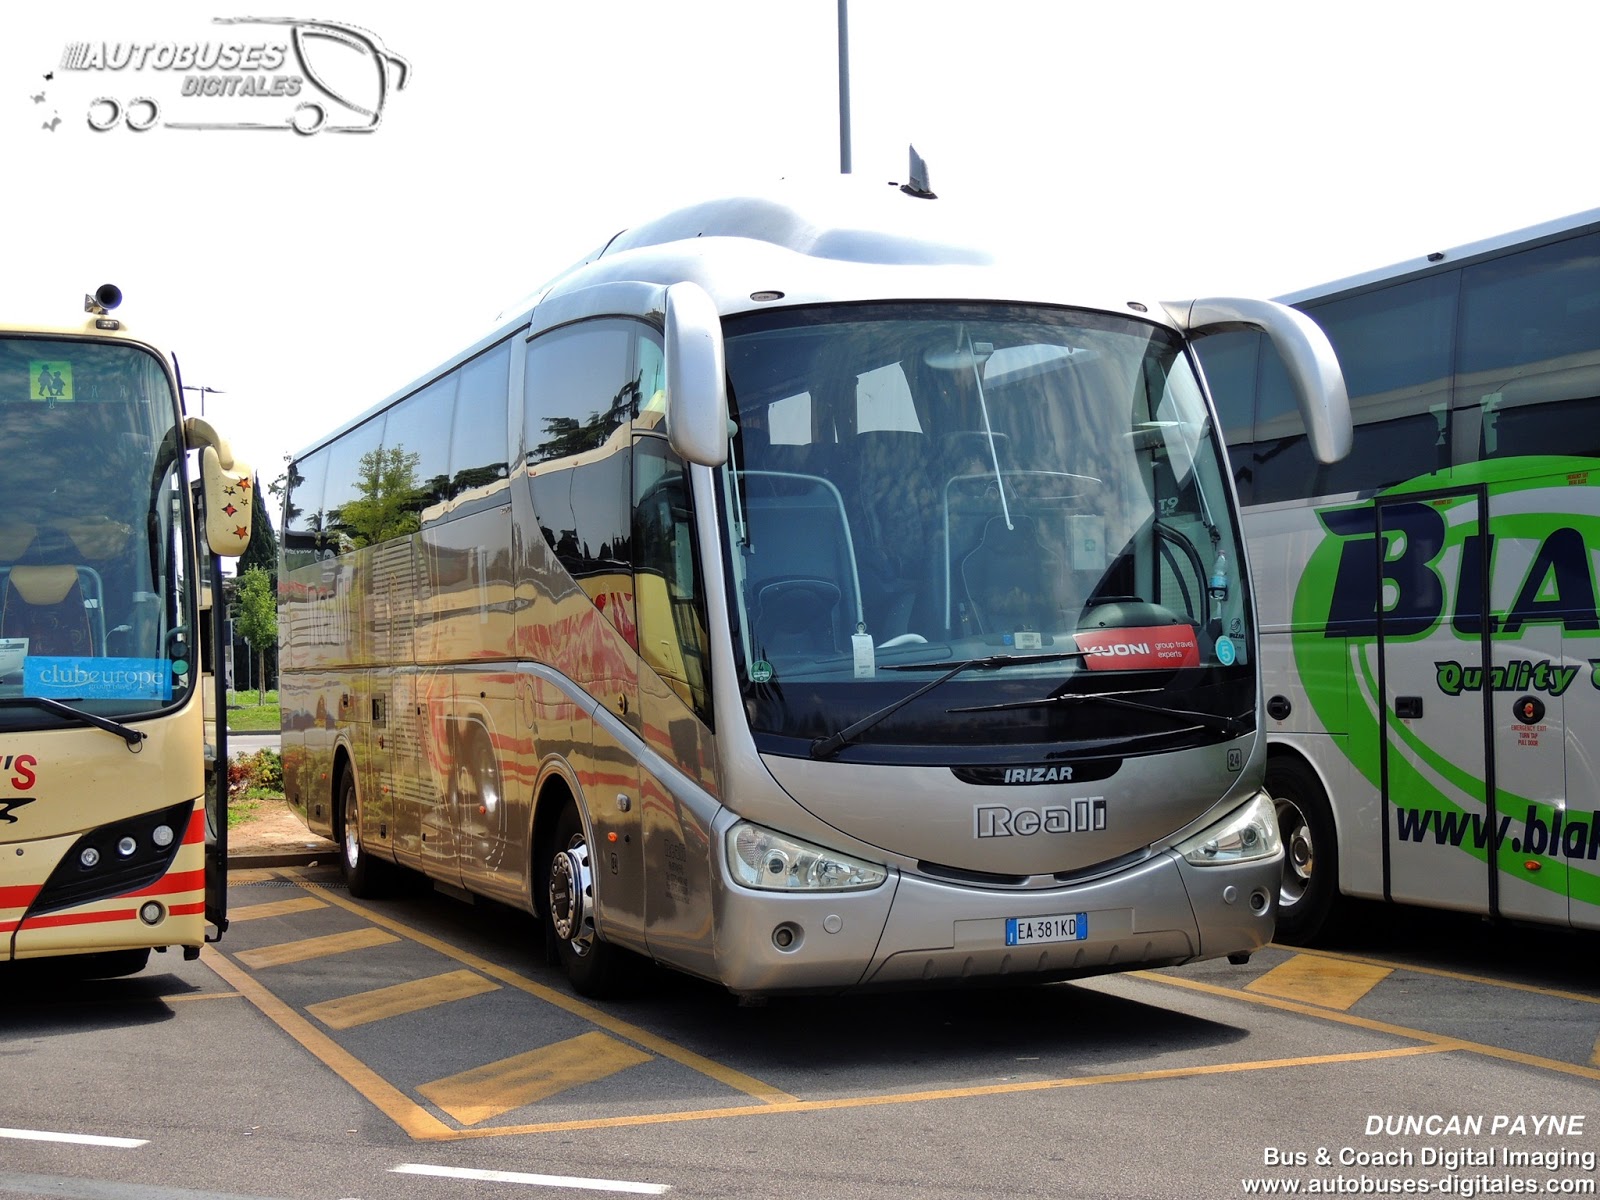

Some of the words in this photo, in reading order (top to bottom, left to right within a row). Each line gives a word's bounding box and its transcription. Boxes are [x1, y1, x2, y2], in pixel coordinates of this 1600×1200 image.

[1083, 643, 1150, 657] KUONI
[1154, 642, 1175, 650] group
[1176, 640, 1194, 648] travel
[1158, 650, 1182, 658] experts
[1221, 645, 1231, 662] 5
[40, 663, 164, 689] clubeurope
[1434, 660, 1582, 696] Quality
[1230, 754, 1240, 767] 24
[0, 754, 37, 790] 'S
[1004, 766, 1073, 784] IRIZAR
[973, 796, 1107, 839] Reali
